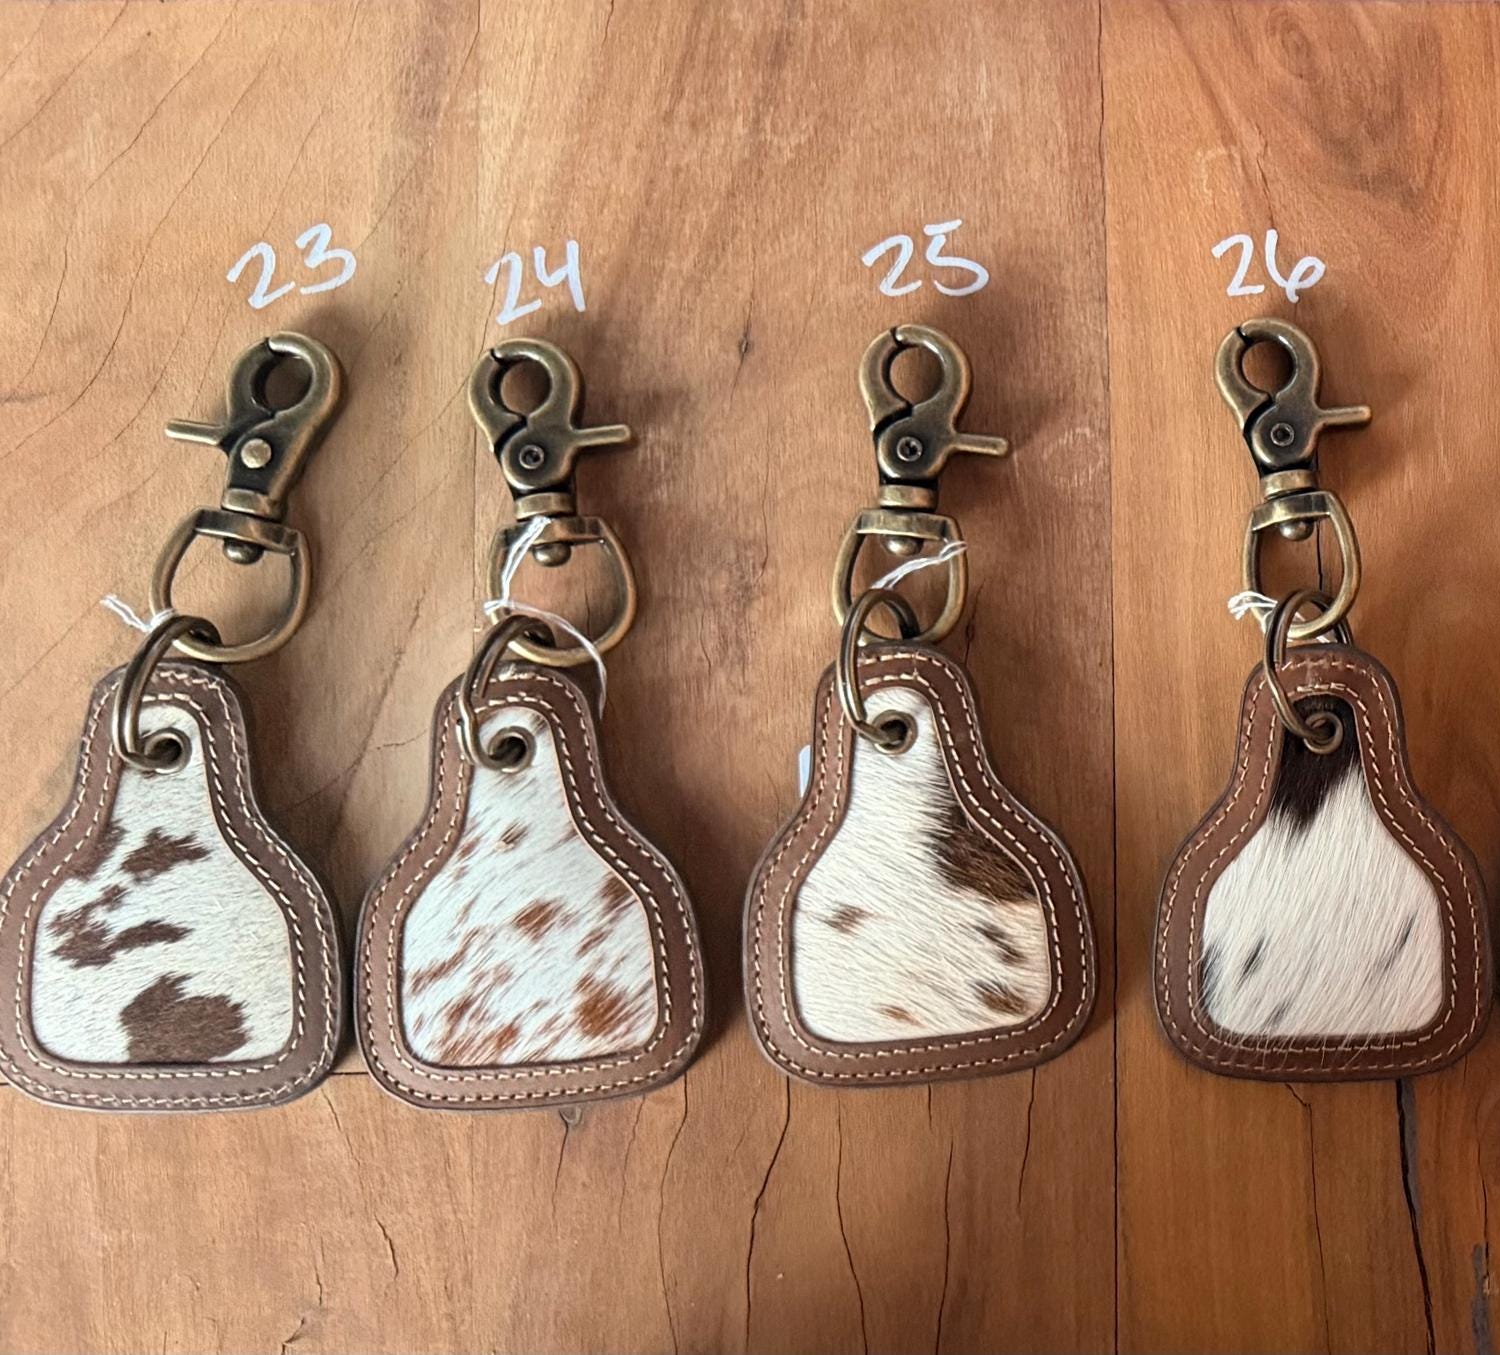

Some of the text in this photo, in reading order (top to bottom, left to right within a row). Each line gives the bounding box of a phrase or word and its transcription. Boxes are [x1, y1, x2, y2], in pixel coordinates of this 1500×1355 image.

[226, 222, 358, 310] 23
[484, 238, 587, 325] 24
[860, 218, 990, 298] 25
[1211, 229, 1329, 304] 26
